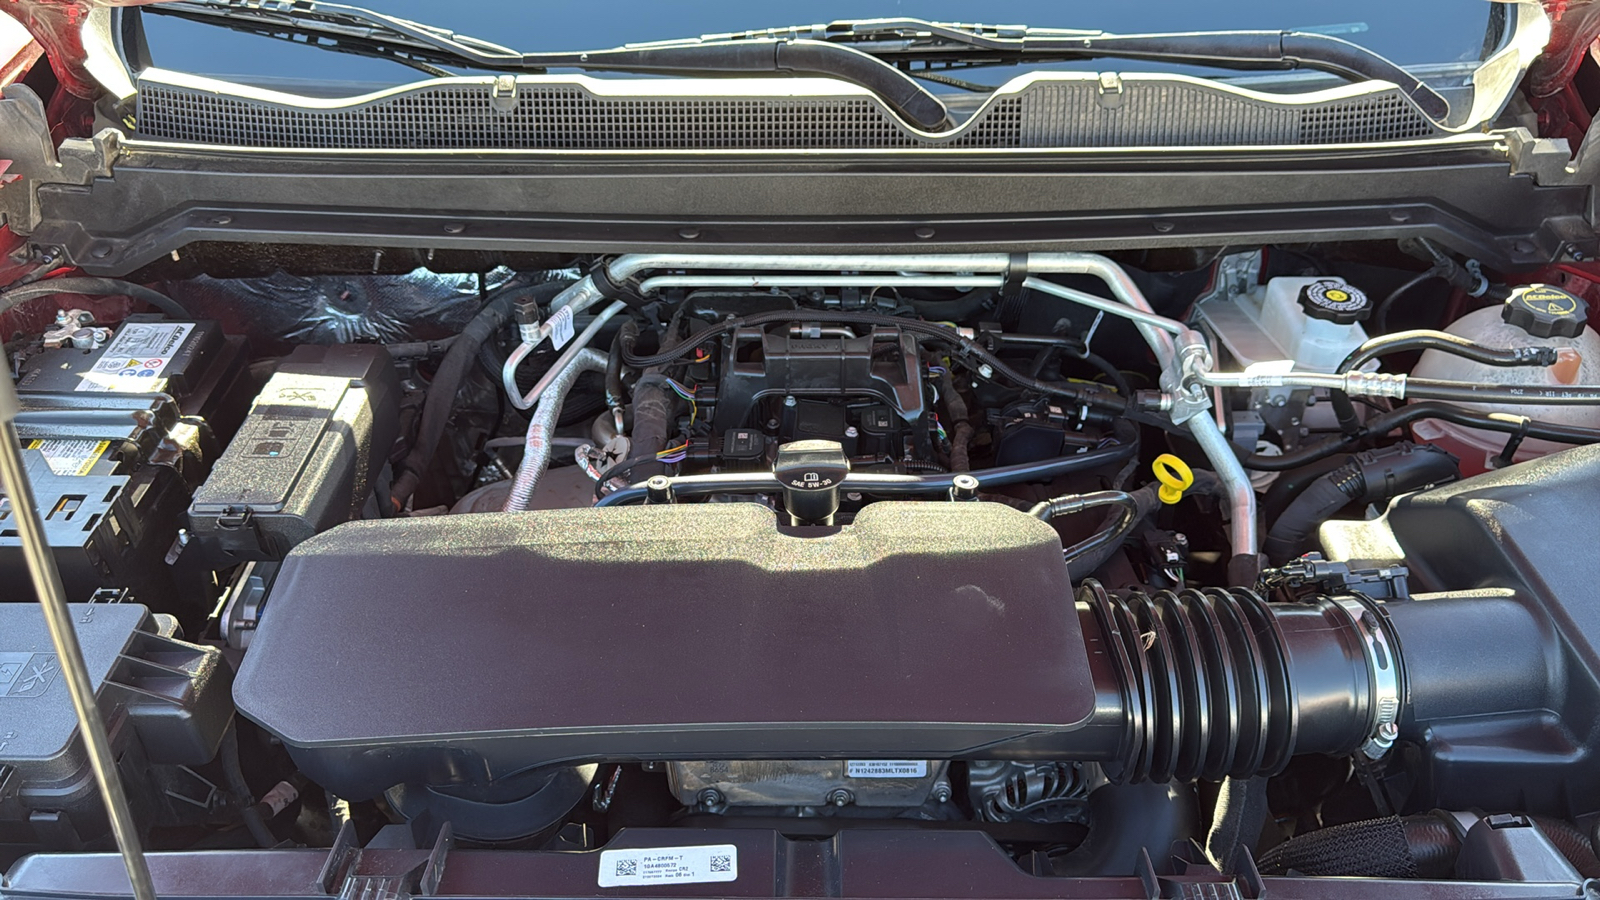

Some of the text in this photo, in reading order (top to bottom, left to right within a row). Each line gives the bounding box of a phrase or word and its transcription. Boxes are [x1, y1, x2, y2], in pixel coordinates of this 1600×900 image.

[161, 325, 186, 355] ACDelco
[791, 478, 832, 488] SAE 5W-30
